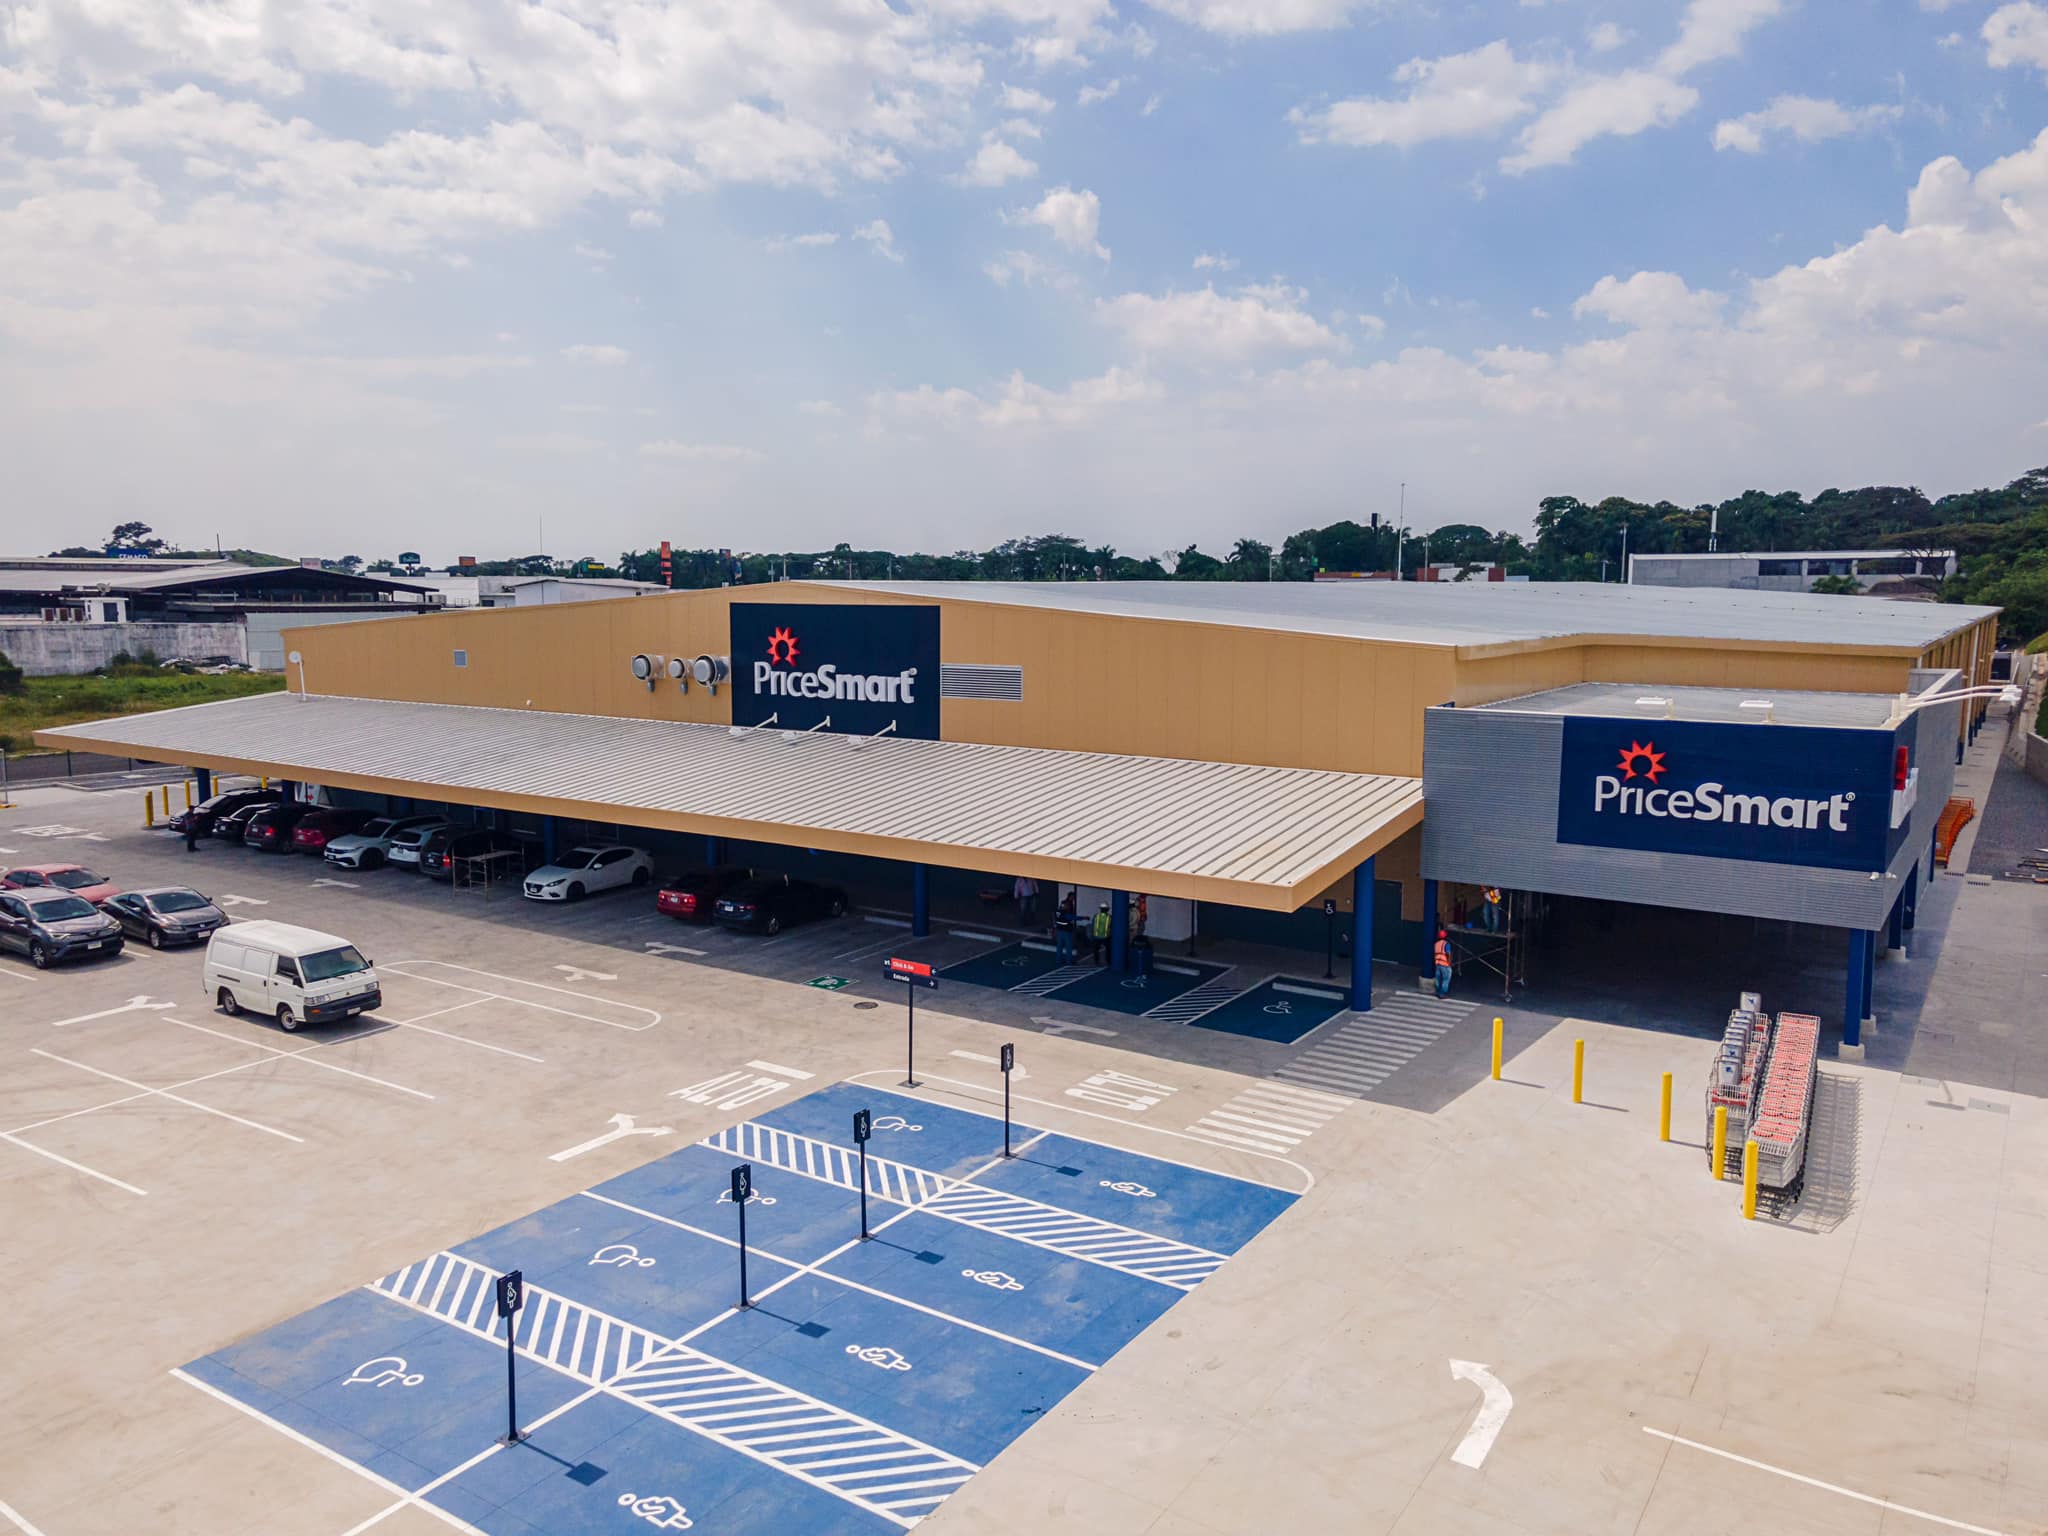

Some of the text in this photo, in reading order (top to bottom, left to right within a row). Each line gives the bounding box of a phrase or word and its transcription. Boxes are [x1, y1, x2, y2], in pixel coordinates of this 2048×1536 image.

[753, 660, 918, 705] PriceSmart
[1594, 775, 1856, 833] PriceSmart
[667, 1070, 791, 1111] ALTO
[1064, 1069, 1179, 1111] ALTO
